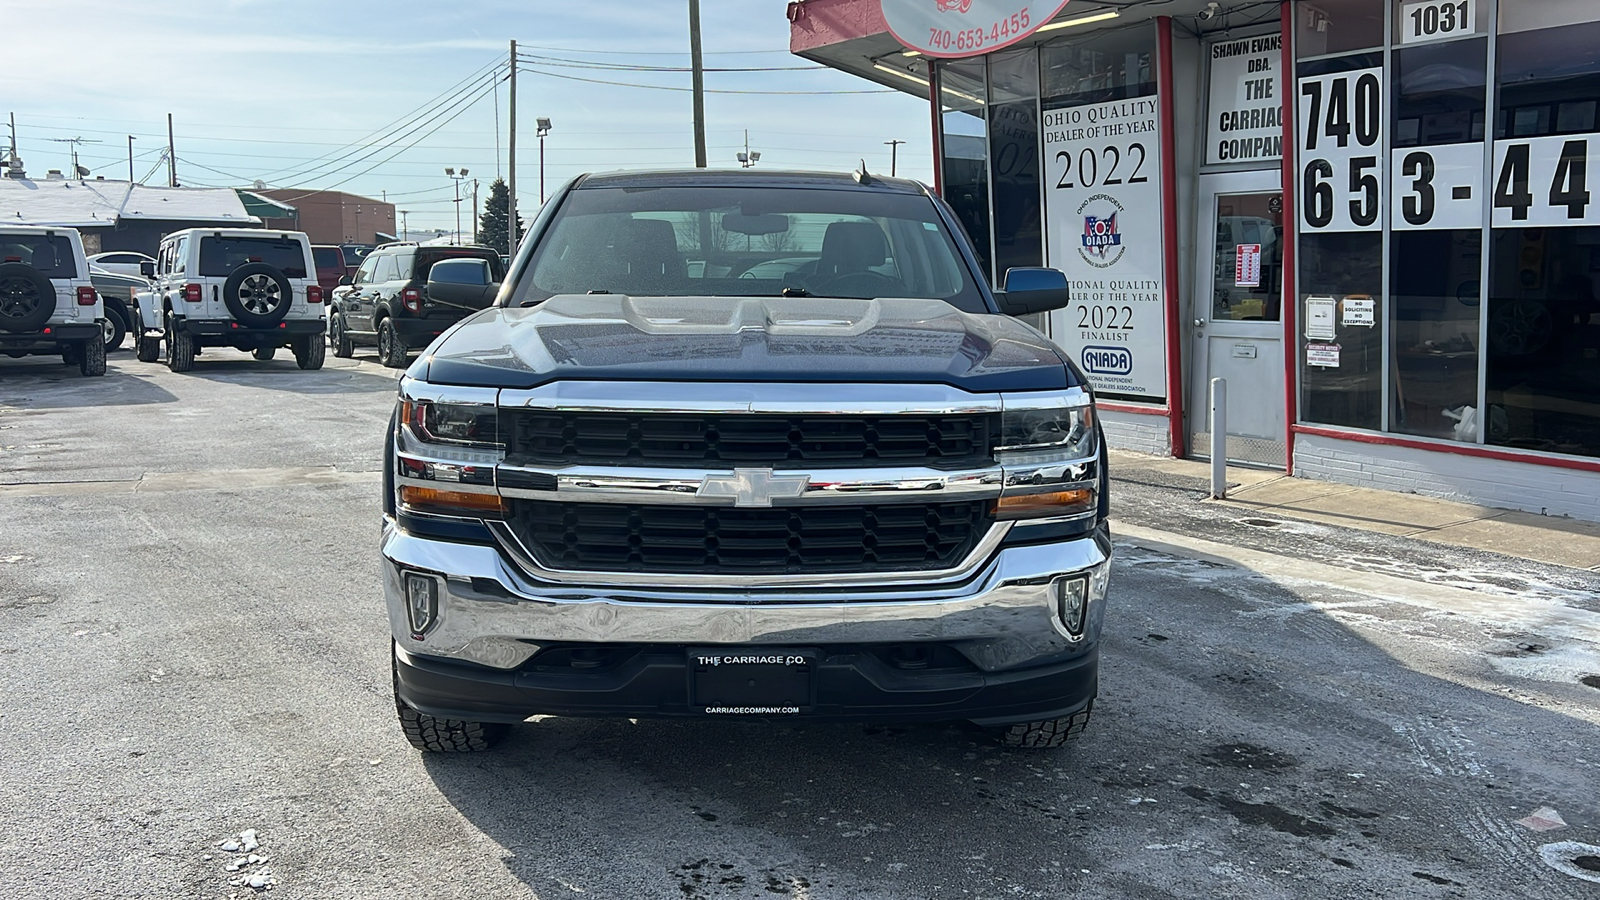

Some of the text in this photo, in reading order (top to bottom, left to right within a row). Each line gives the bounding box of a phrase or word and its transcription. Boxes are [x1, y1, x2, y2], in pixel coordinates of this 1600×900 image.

[928, 7, 1031, 50] 740-653-4455
[1410, 2, 1468, 37] 1031
[1213, 41, 1249, 59] SHAWN
[1247, 57, 1272, 73] DBA.
[1244, 78, 1273, 101] THE
[1044, 99, 1157, 127] OHIO QUALITY
[1219, 106, 1283, 132] CARRIA
[1301, 73, 1380, 151] 740
[1046, 119, 1156, 144] DEALER OF THE YEAR
[1218, 135, 1283, 160] COMPAN
[1055, 142, 1149, 190] 2022
[1076, 193, 1125, 215] OHIO INDEPENDENT
[1086, 234, 1115, 246] OIADA
[1067, 280, 1160, 292] IONAL QUALITY
[1069, 292, 1159, 302] LER OF THE YEAR
[1077, 304, 1134, 330] 2022
[1081, 331, 1129, 341] FINALIST
[1085, 351, 1127, 370] NIADA
[1104, 376, 1133, 384] INDEPENDENT
[698, 656, 806, 666] THE CARRIAGE CO.
